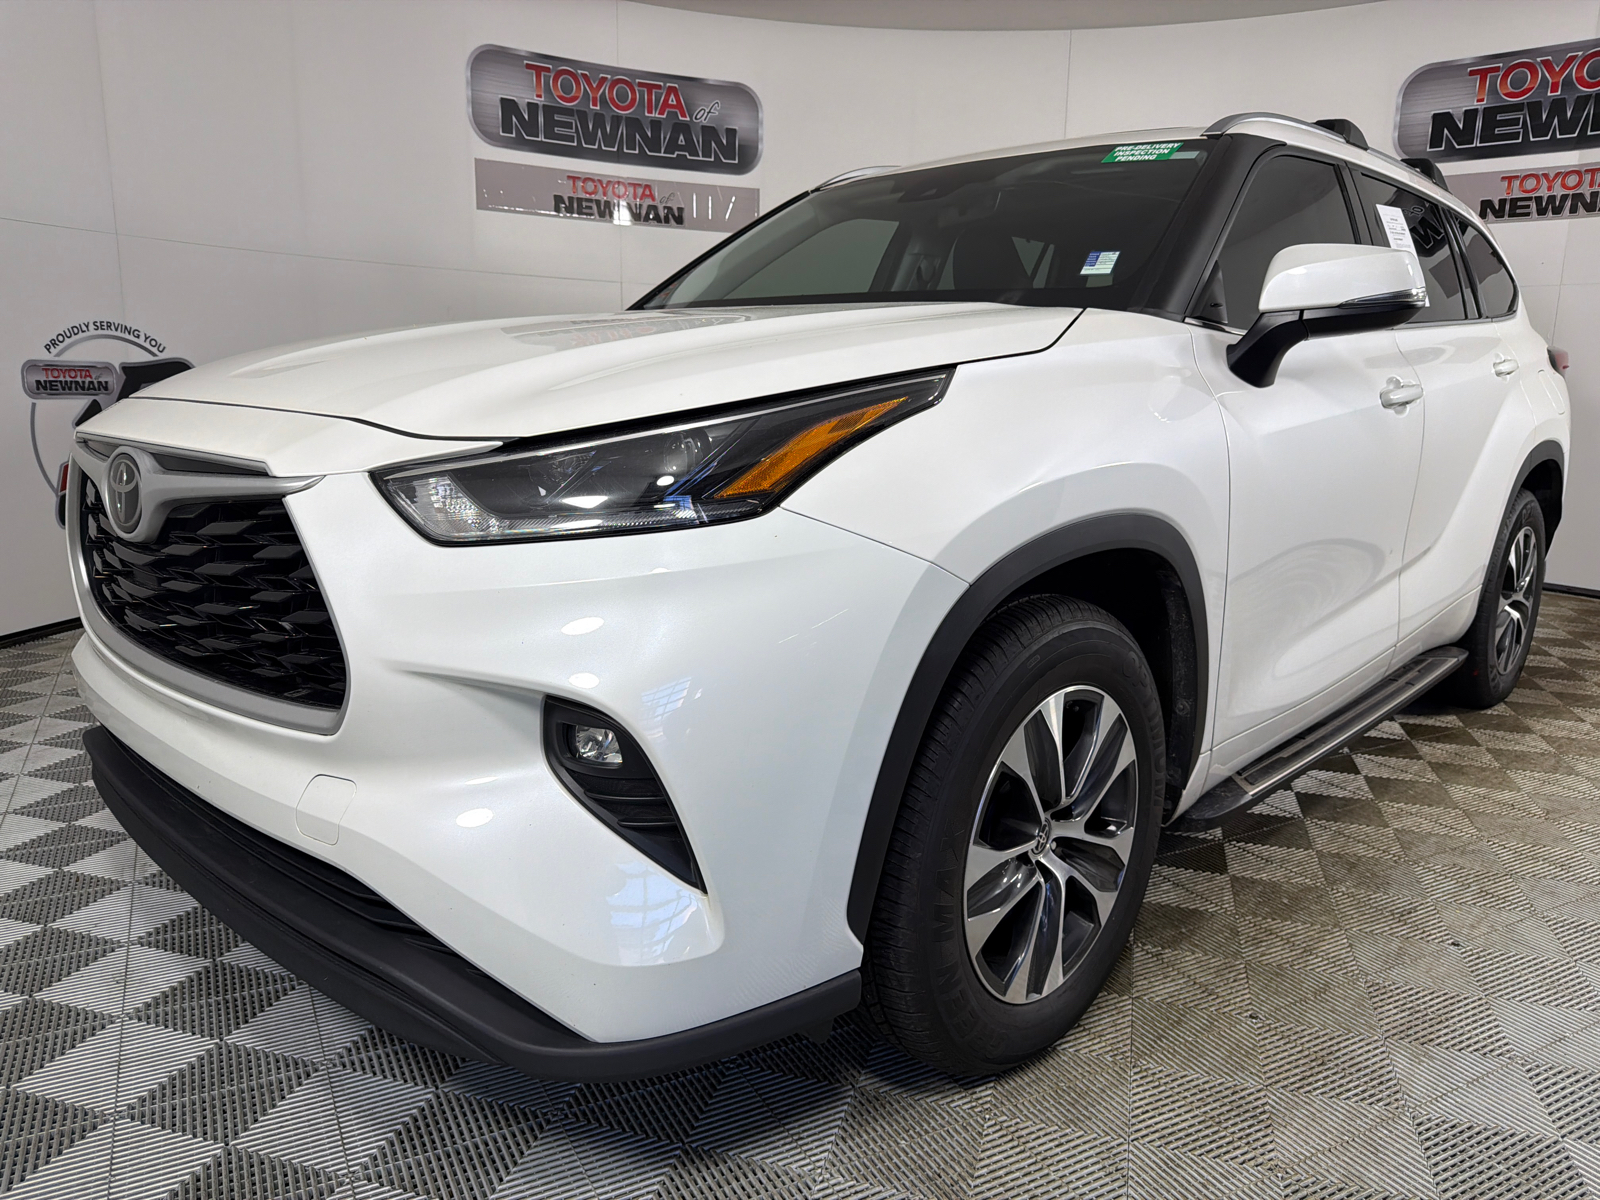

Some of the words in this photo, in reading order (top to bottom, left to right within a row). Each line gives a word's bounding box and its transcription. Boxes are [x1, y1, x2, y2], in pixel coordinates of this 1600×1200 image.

[524, 61, 689, 120] TOYOTA
[693, 100, 720, 123] of
[500, 97, 738, 164] NEWNAN
[1114, 148, 1171, 156] INSPECTION
[1115, 142, 1181, 151] PRE-DELIVERY
[567, 175, 656, 202] TOYOTA
[660, 192, 675, 205] of
[1501, 167, 1600, 195] TOYOT
[1479, 190, 1600, 219] NEWN
[44, 321, 90, 354] PROUDLY
[92, 320, 141, 339] SERVING
[143, 332, 167, 354] YOU
[35, 379, 109, 392] NEWNAN
[42, 367, 93, 380] TOYOTA
